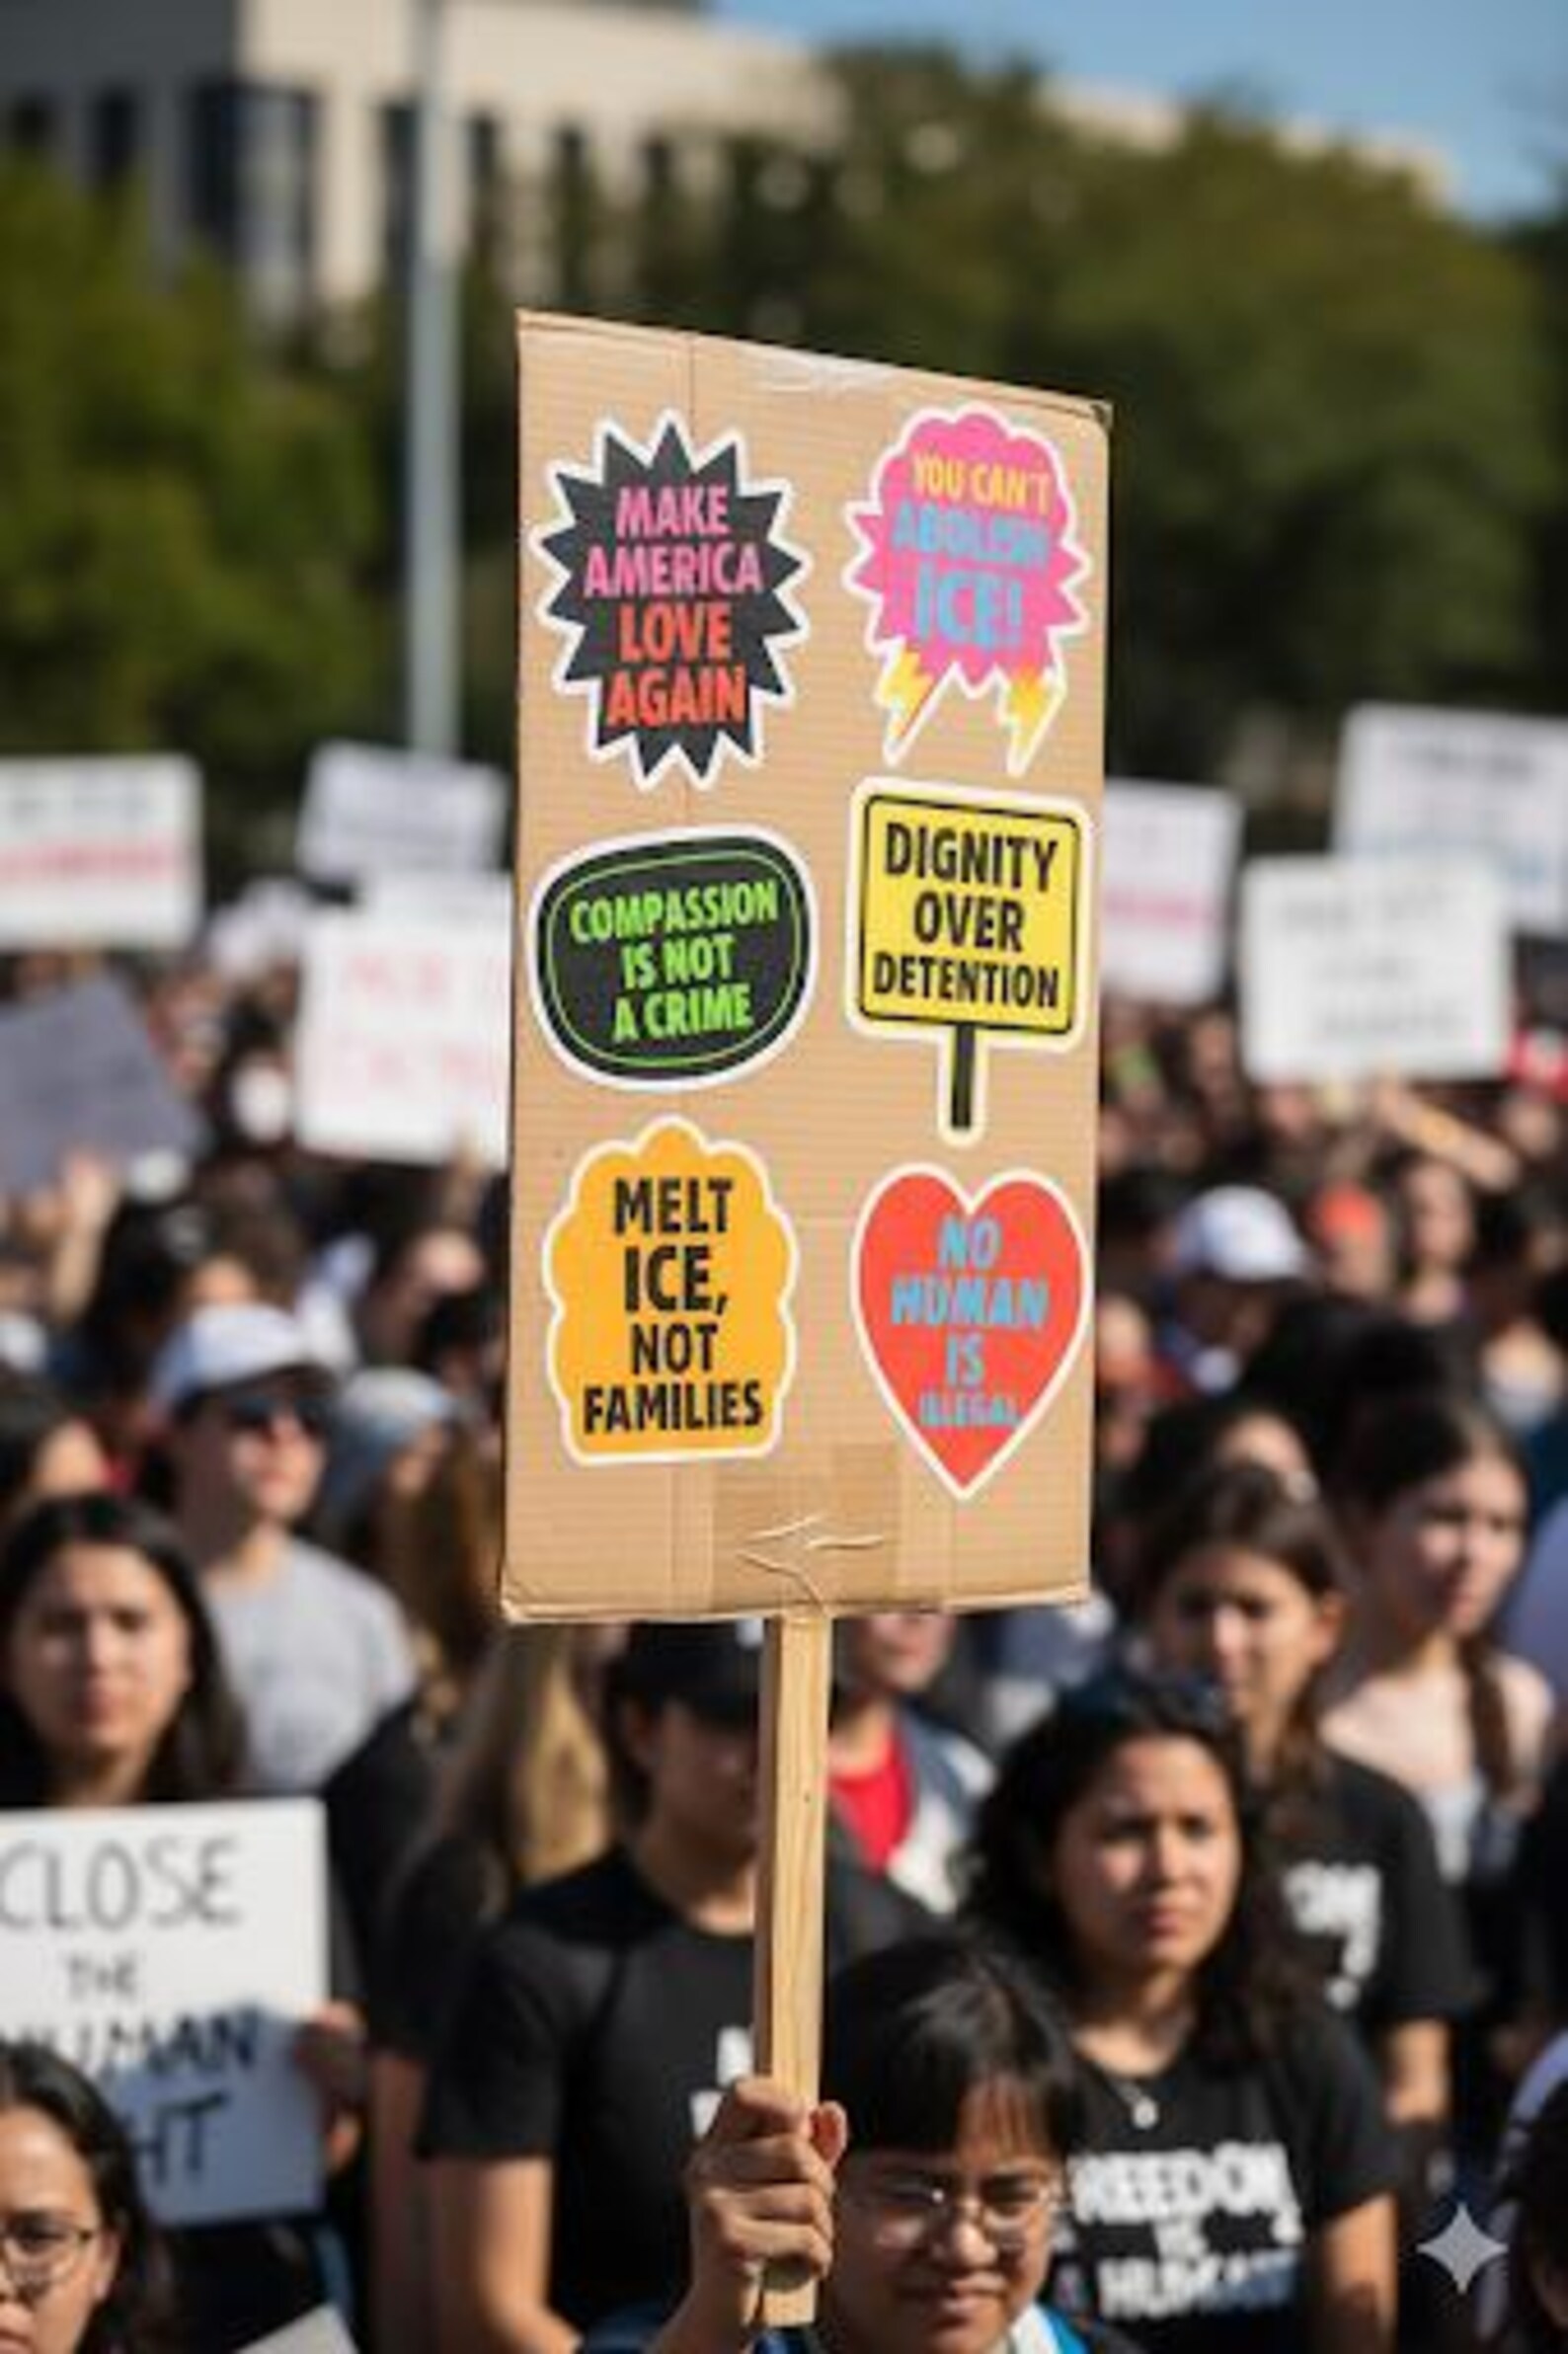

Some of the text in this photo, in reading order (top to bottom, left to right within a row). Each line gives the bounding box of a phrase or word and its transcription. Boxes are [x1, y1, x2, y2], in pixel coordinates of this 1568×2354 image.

[615, 486, 730, 538] MAKE
[914, 453, 1052, 515] YOU CAN'T
[584, 542, 764, 597] AMERICA
[620, 602, 733, 664] LOVE
[915, 564, 1023, 649] ICE!
[606, 667, 747, 727] AGAIN
[885, 822, 1059, 892] DIGNITY
[569, 881, 778, 943] COMPASSION
[913, 891, 1025, 952] OVER
[622, 934, 736, 990] IS NOT
[874, 951, 1059, 1009] DETENTION
[612, 983, 753, 1042] A CRIME
[614, 1177, 735, 1234] MELT
[939, 1217, 1001, 1269] NO
[624, 1248, 729, 1315] ICE,
[631, 1325, 719, 1374] NOT
[947, 1337, 984, 1386] IS
[583, 1381, 762, 1434] FAMILIES
[0, 1835, 240, 1928] CLOSE
